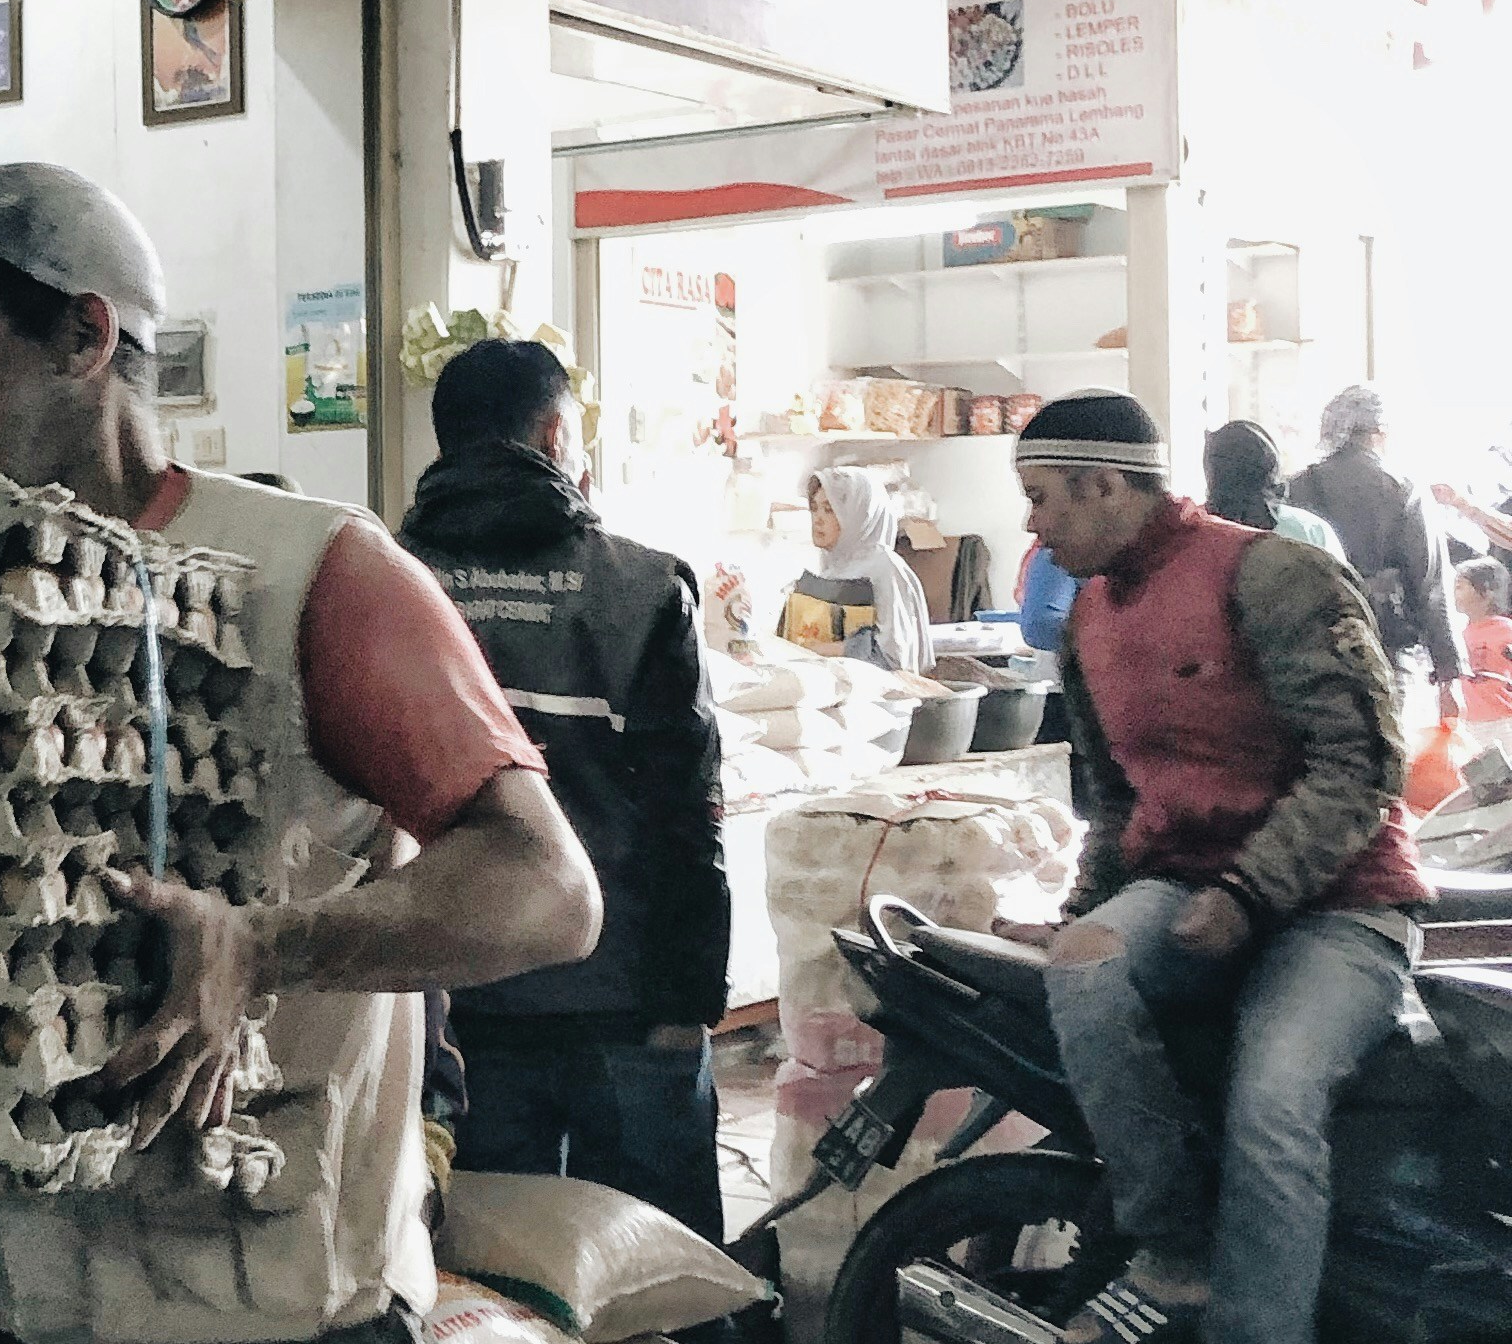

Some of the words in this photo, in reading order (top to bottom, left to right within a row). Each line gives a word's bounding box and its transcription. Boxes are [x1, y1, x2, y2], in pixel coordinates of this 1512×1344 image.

[1065, 16, 1140, 39] LEMPER
[875, 128, 919, 144] Pasar
[1069, 103, 1144, 122] Lembang
[642, 266, 672, 298] CITA
[677, 271, 711, 303] RASA
